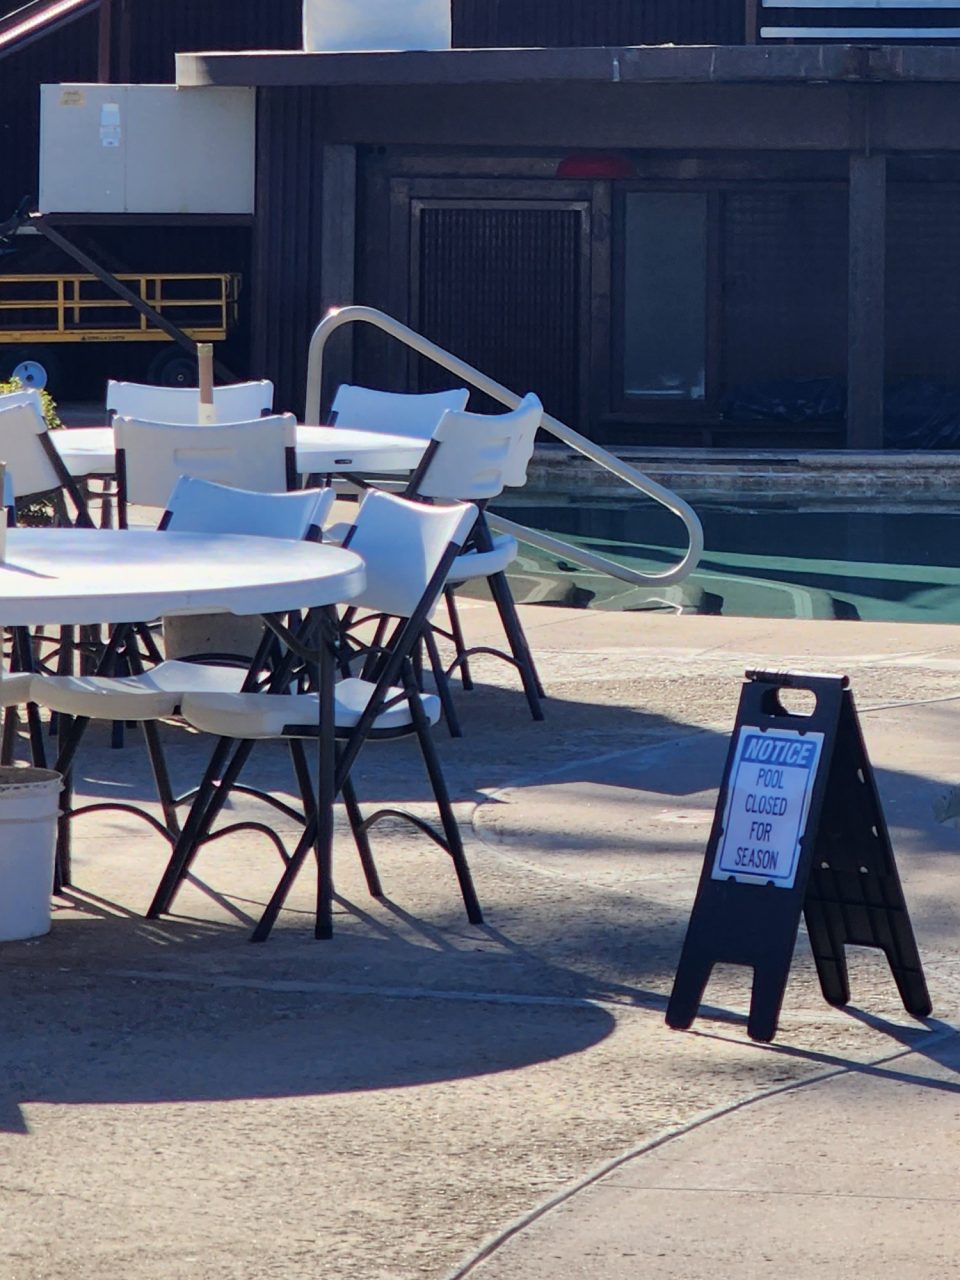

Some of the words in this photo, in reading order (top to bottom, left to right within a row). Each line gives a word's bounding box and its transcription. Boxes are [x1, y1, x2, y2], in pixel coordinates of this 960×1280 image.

[745, 738, 813, 765] NOTICE
[756, 768, 784, 789] POOL
[745, 794, 787, 816] CLOSED
[749, 821, 772, 842] FOR
[735, 847, 779, 870] SEASON
